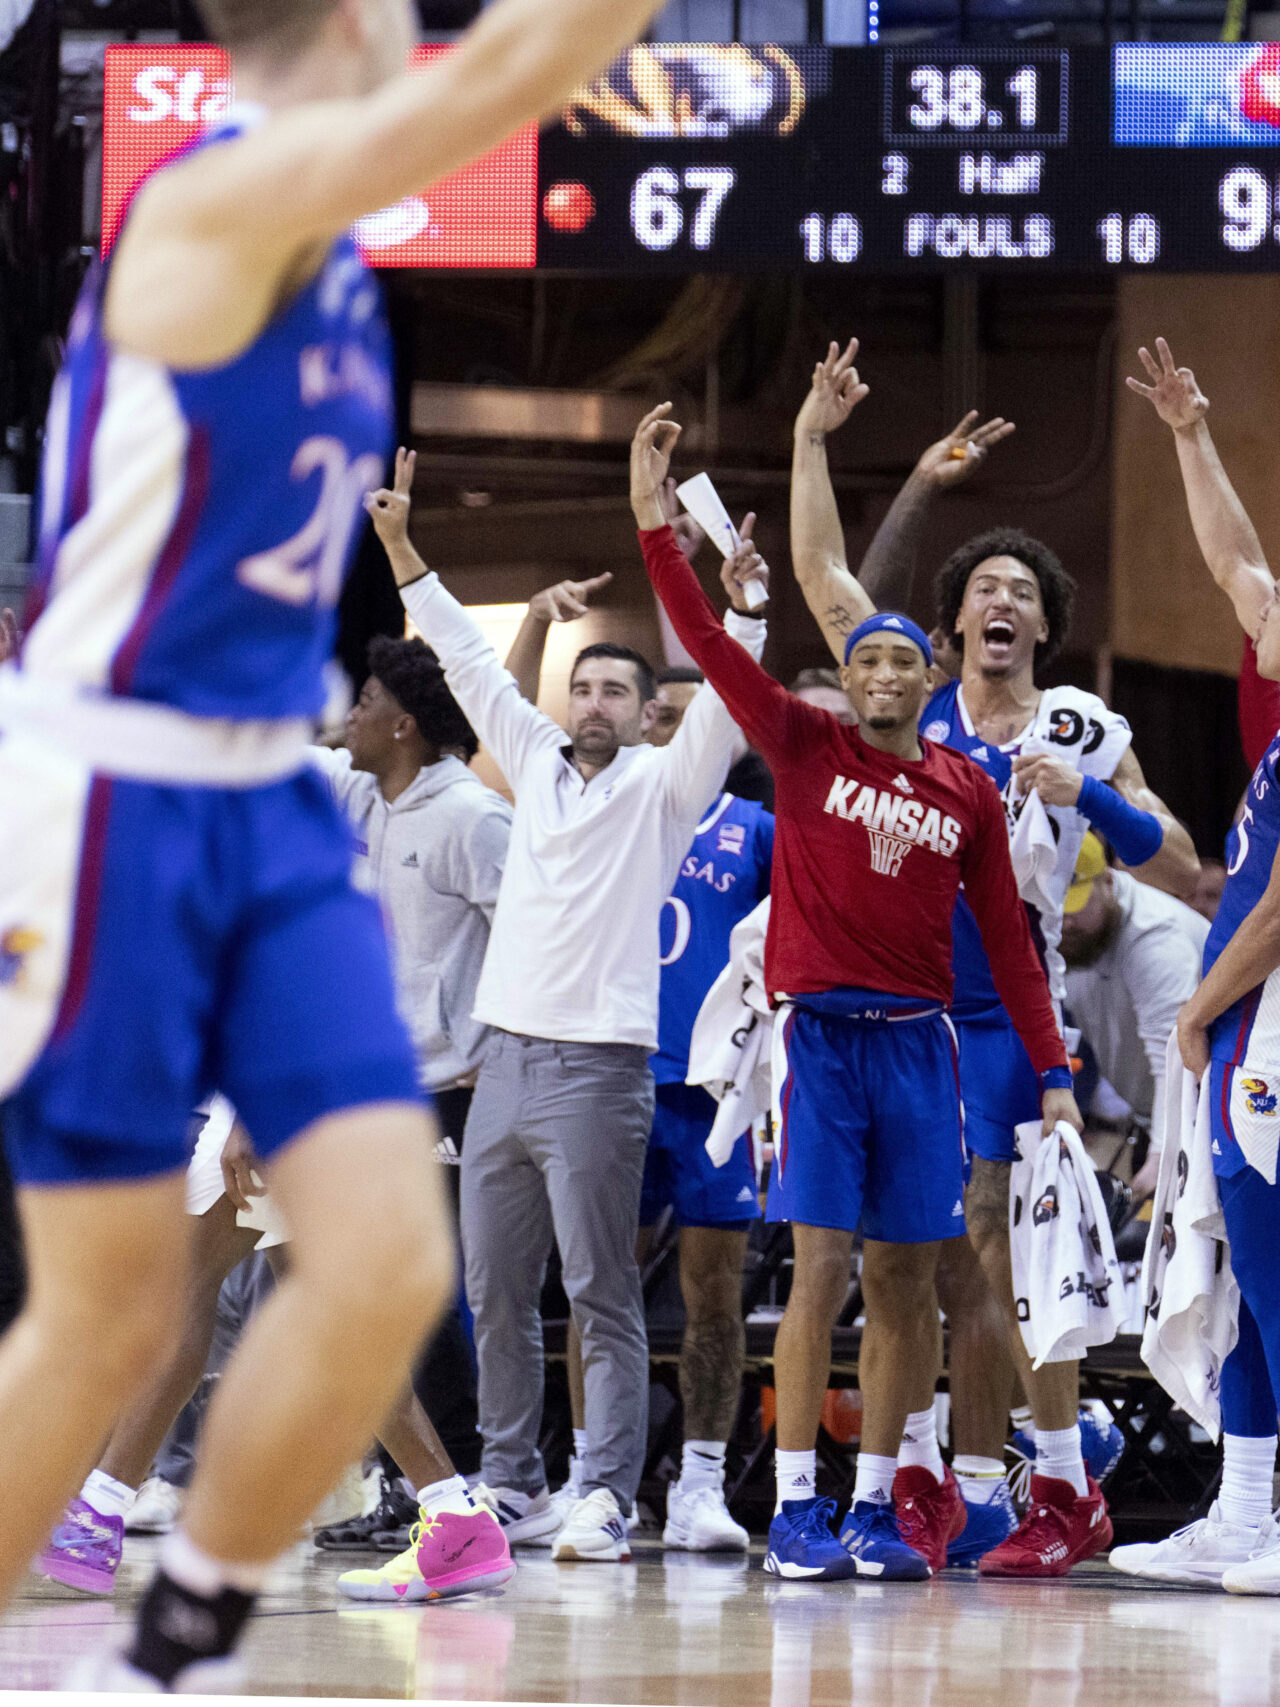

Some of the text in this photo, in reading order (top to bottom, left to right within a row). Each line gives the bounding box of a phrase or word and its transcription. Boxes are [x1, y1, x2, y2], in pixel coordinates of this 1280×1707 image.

[911, 65, 1037, 129] 38.1
[630, 166, 736, 250] 67
[801, 212, 861, 262] 10
[905, 213, 1052, 257] FOULS
[1097, 213, 1160, 263] 10
[823, 774, 962, 858] KANSAS
[868, 831, 912, 878] HOOPS
